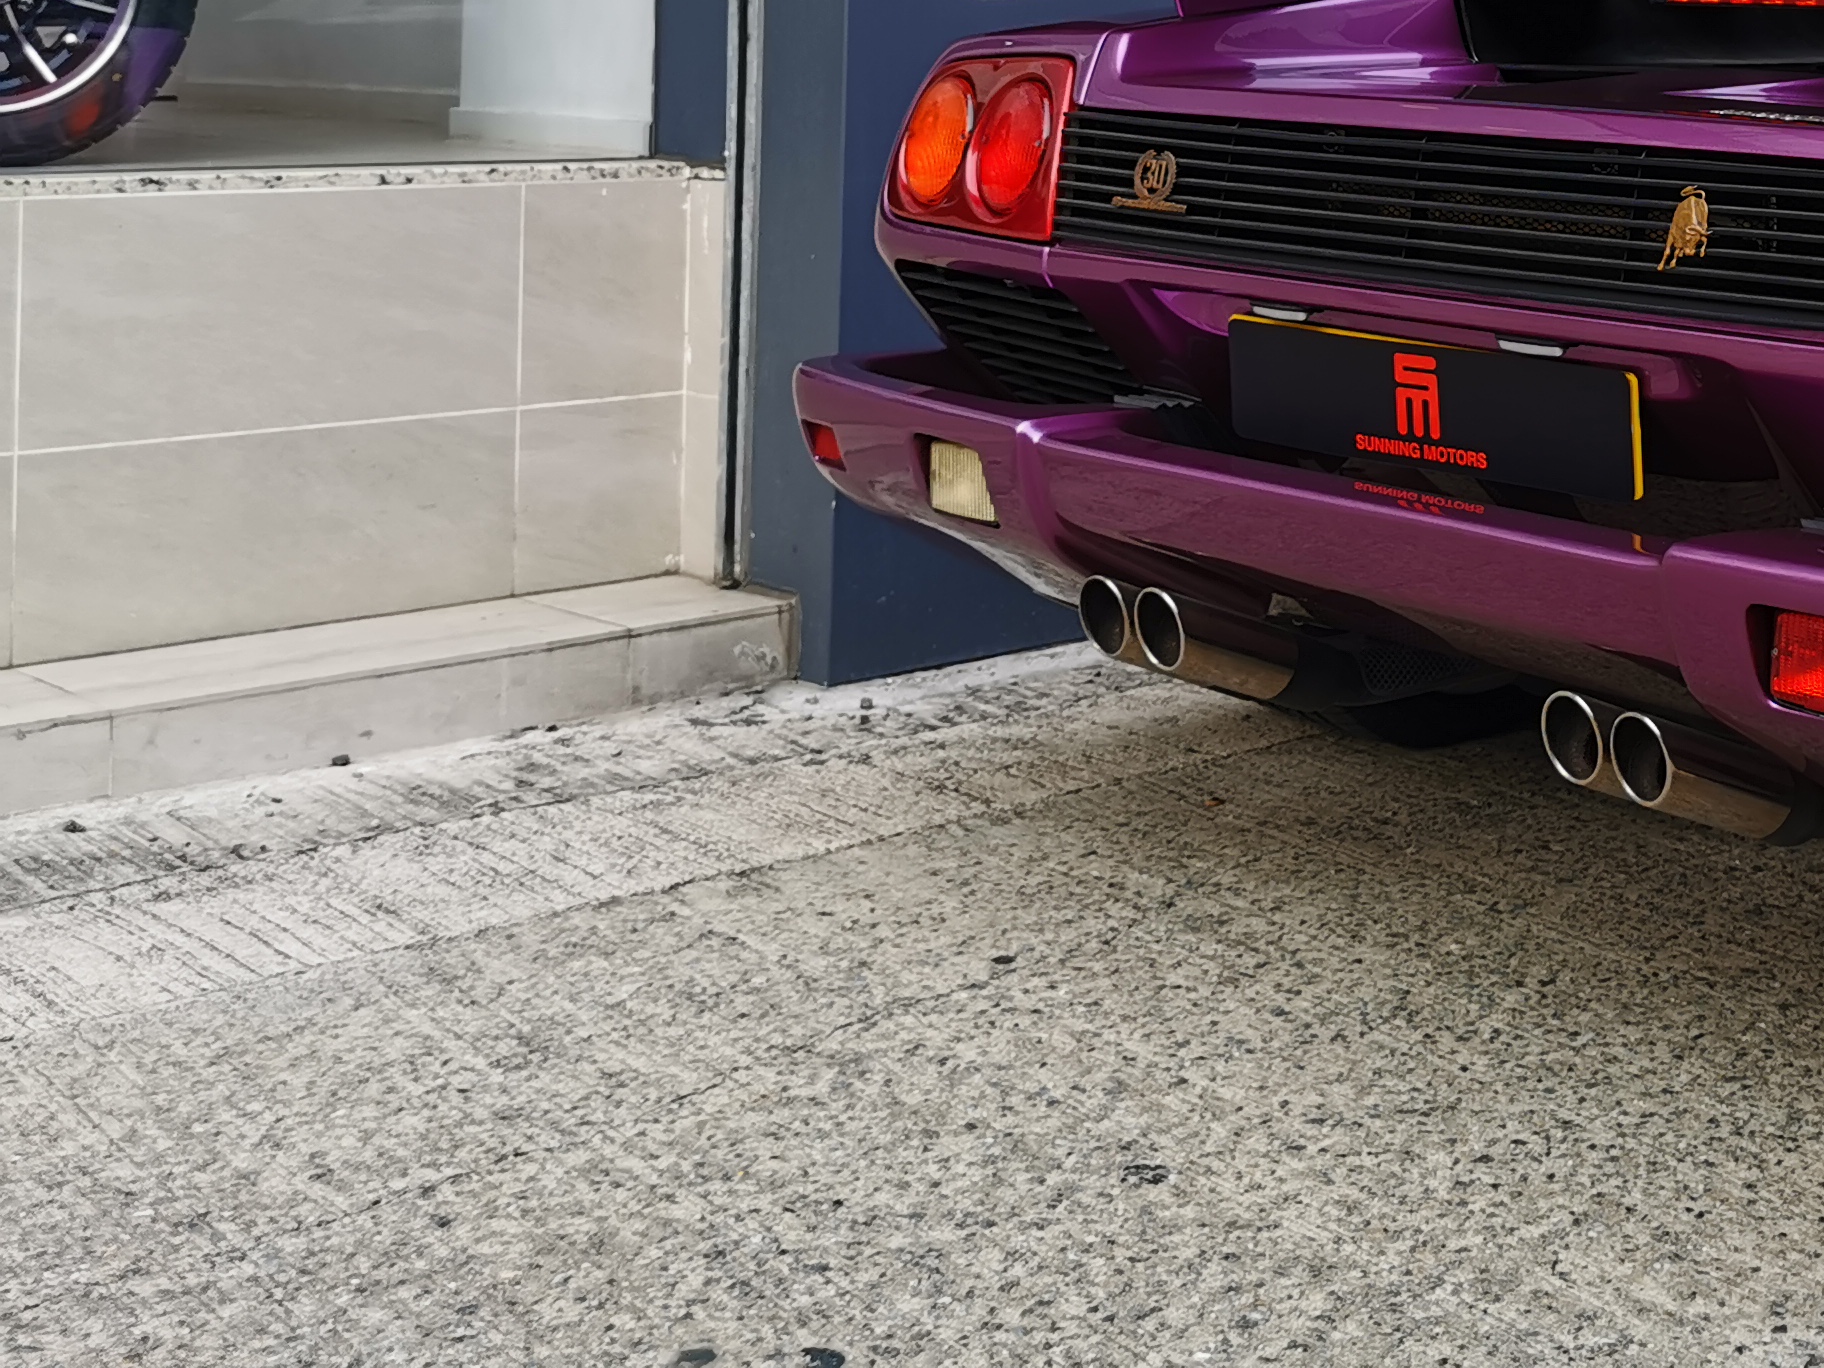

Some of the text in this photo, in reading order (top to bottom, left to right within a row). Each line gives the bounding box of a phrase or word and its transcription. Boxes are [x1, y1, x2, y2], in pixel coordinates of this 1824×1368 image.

[1144, 160, 1166, 188] 30
[1356, 434, 1488, 469] SUNNING MOTORS
